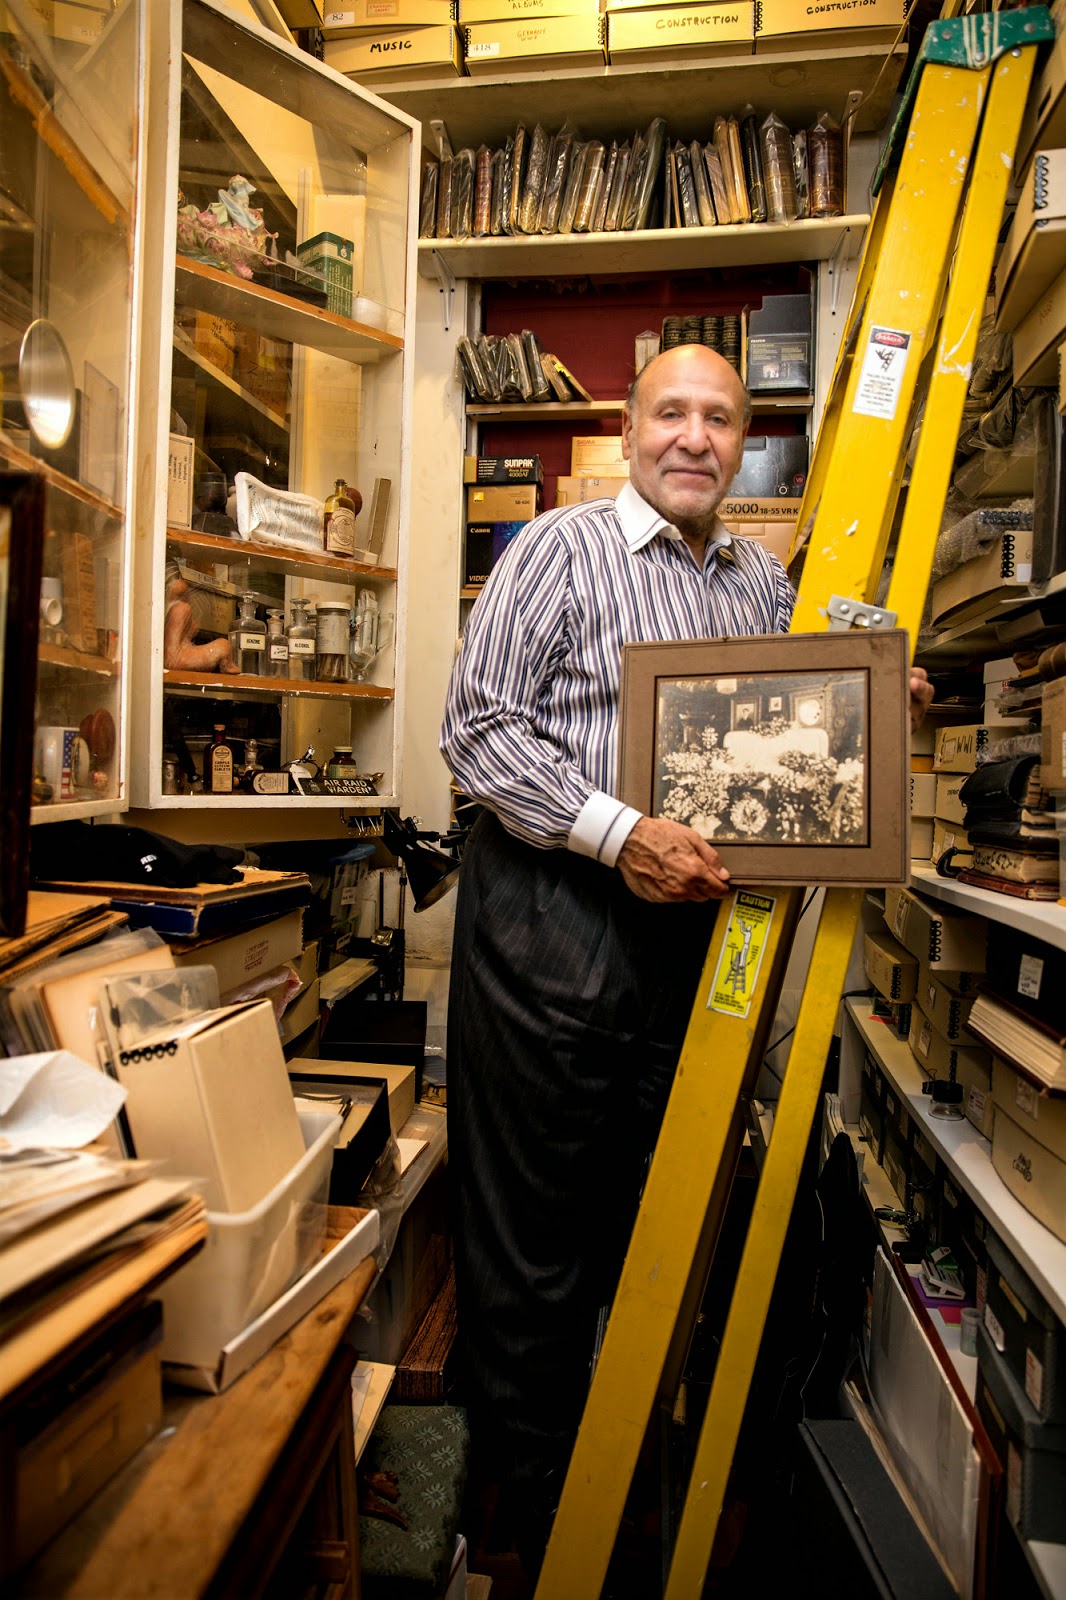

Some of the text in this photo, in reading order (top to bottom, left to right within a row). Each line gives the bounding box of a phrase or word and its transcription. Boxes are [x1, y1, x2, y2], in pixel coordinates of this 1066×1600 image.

[512, 1, 544, 10] ALBUMS
[806, 0, 877, 15] CONSTRUCTION
[332, 13, 344, 21] 82
[655, 15, 739, 30] CONSTRUCTION
[369, 40, 413, 53] MUSIC
[324, 779, 368, 787] AIR RAID
[326, 786, 370, 794] WARDEN
[739, 894, 771, 909] CAUTION
